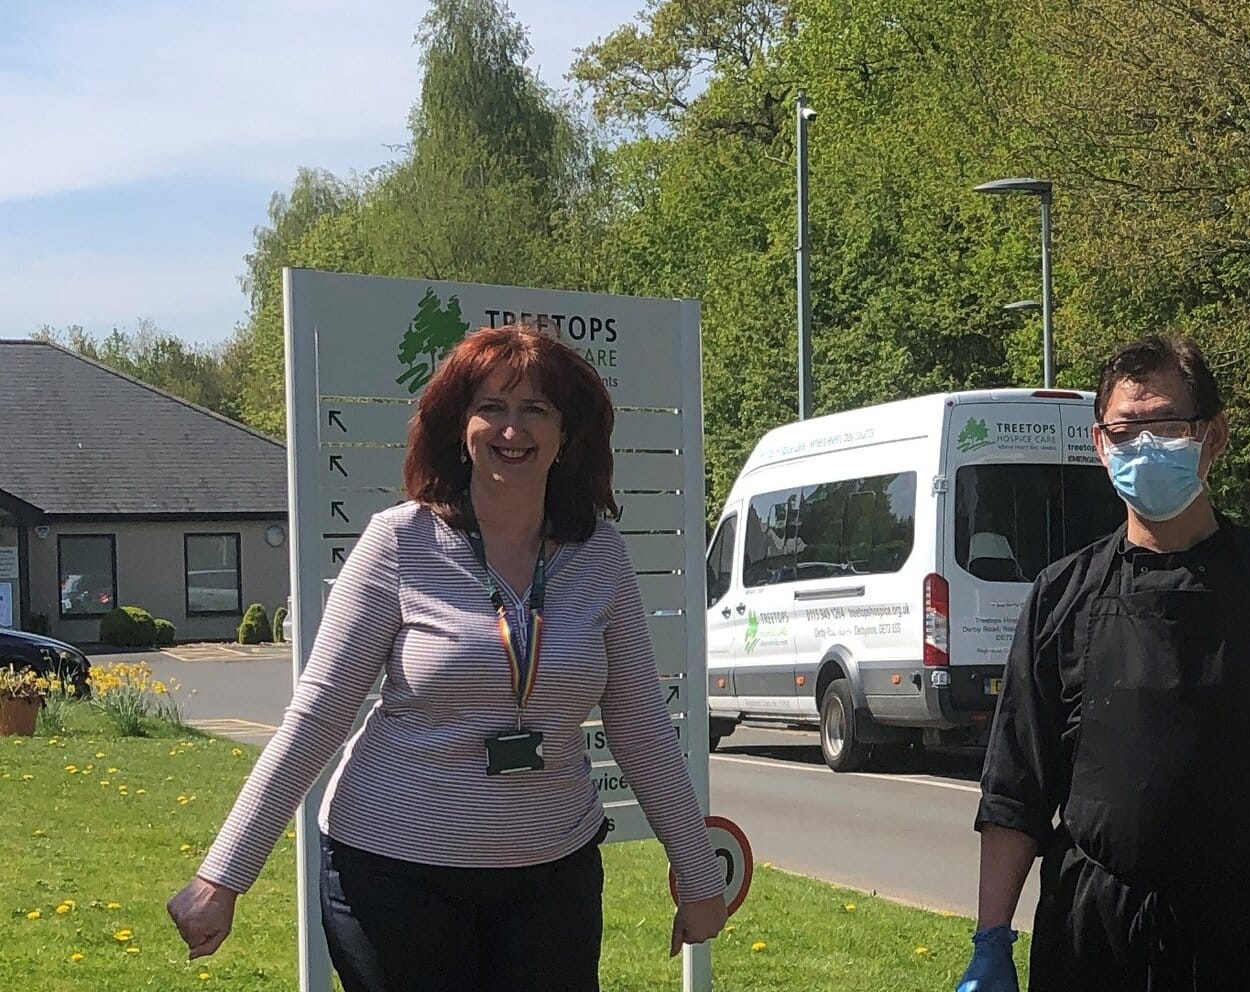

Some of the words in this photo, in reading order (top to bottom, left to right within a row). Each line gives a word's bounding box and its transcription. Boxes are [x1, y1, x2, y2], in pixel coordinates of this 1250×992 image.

[575, 347, 617, 367] ARE
[996, 423, 1056, 434] TREETOPS
[1067, 425, 1095, 439] 011
